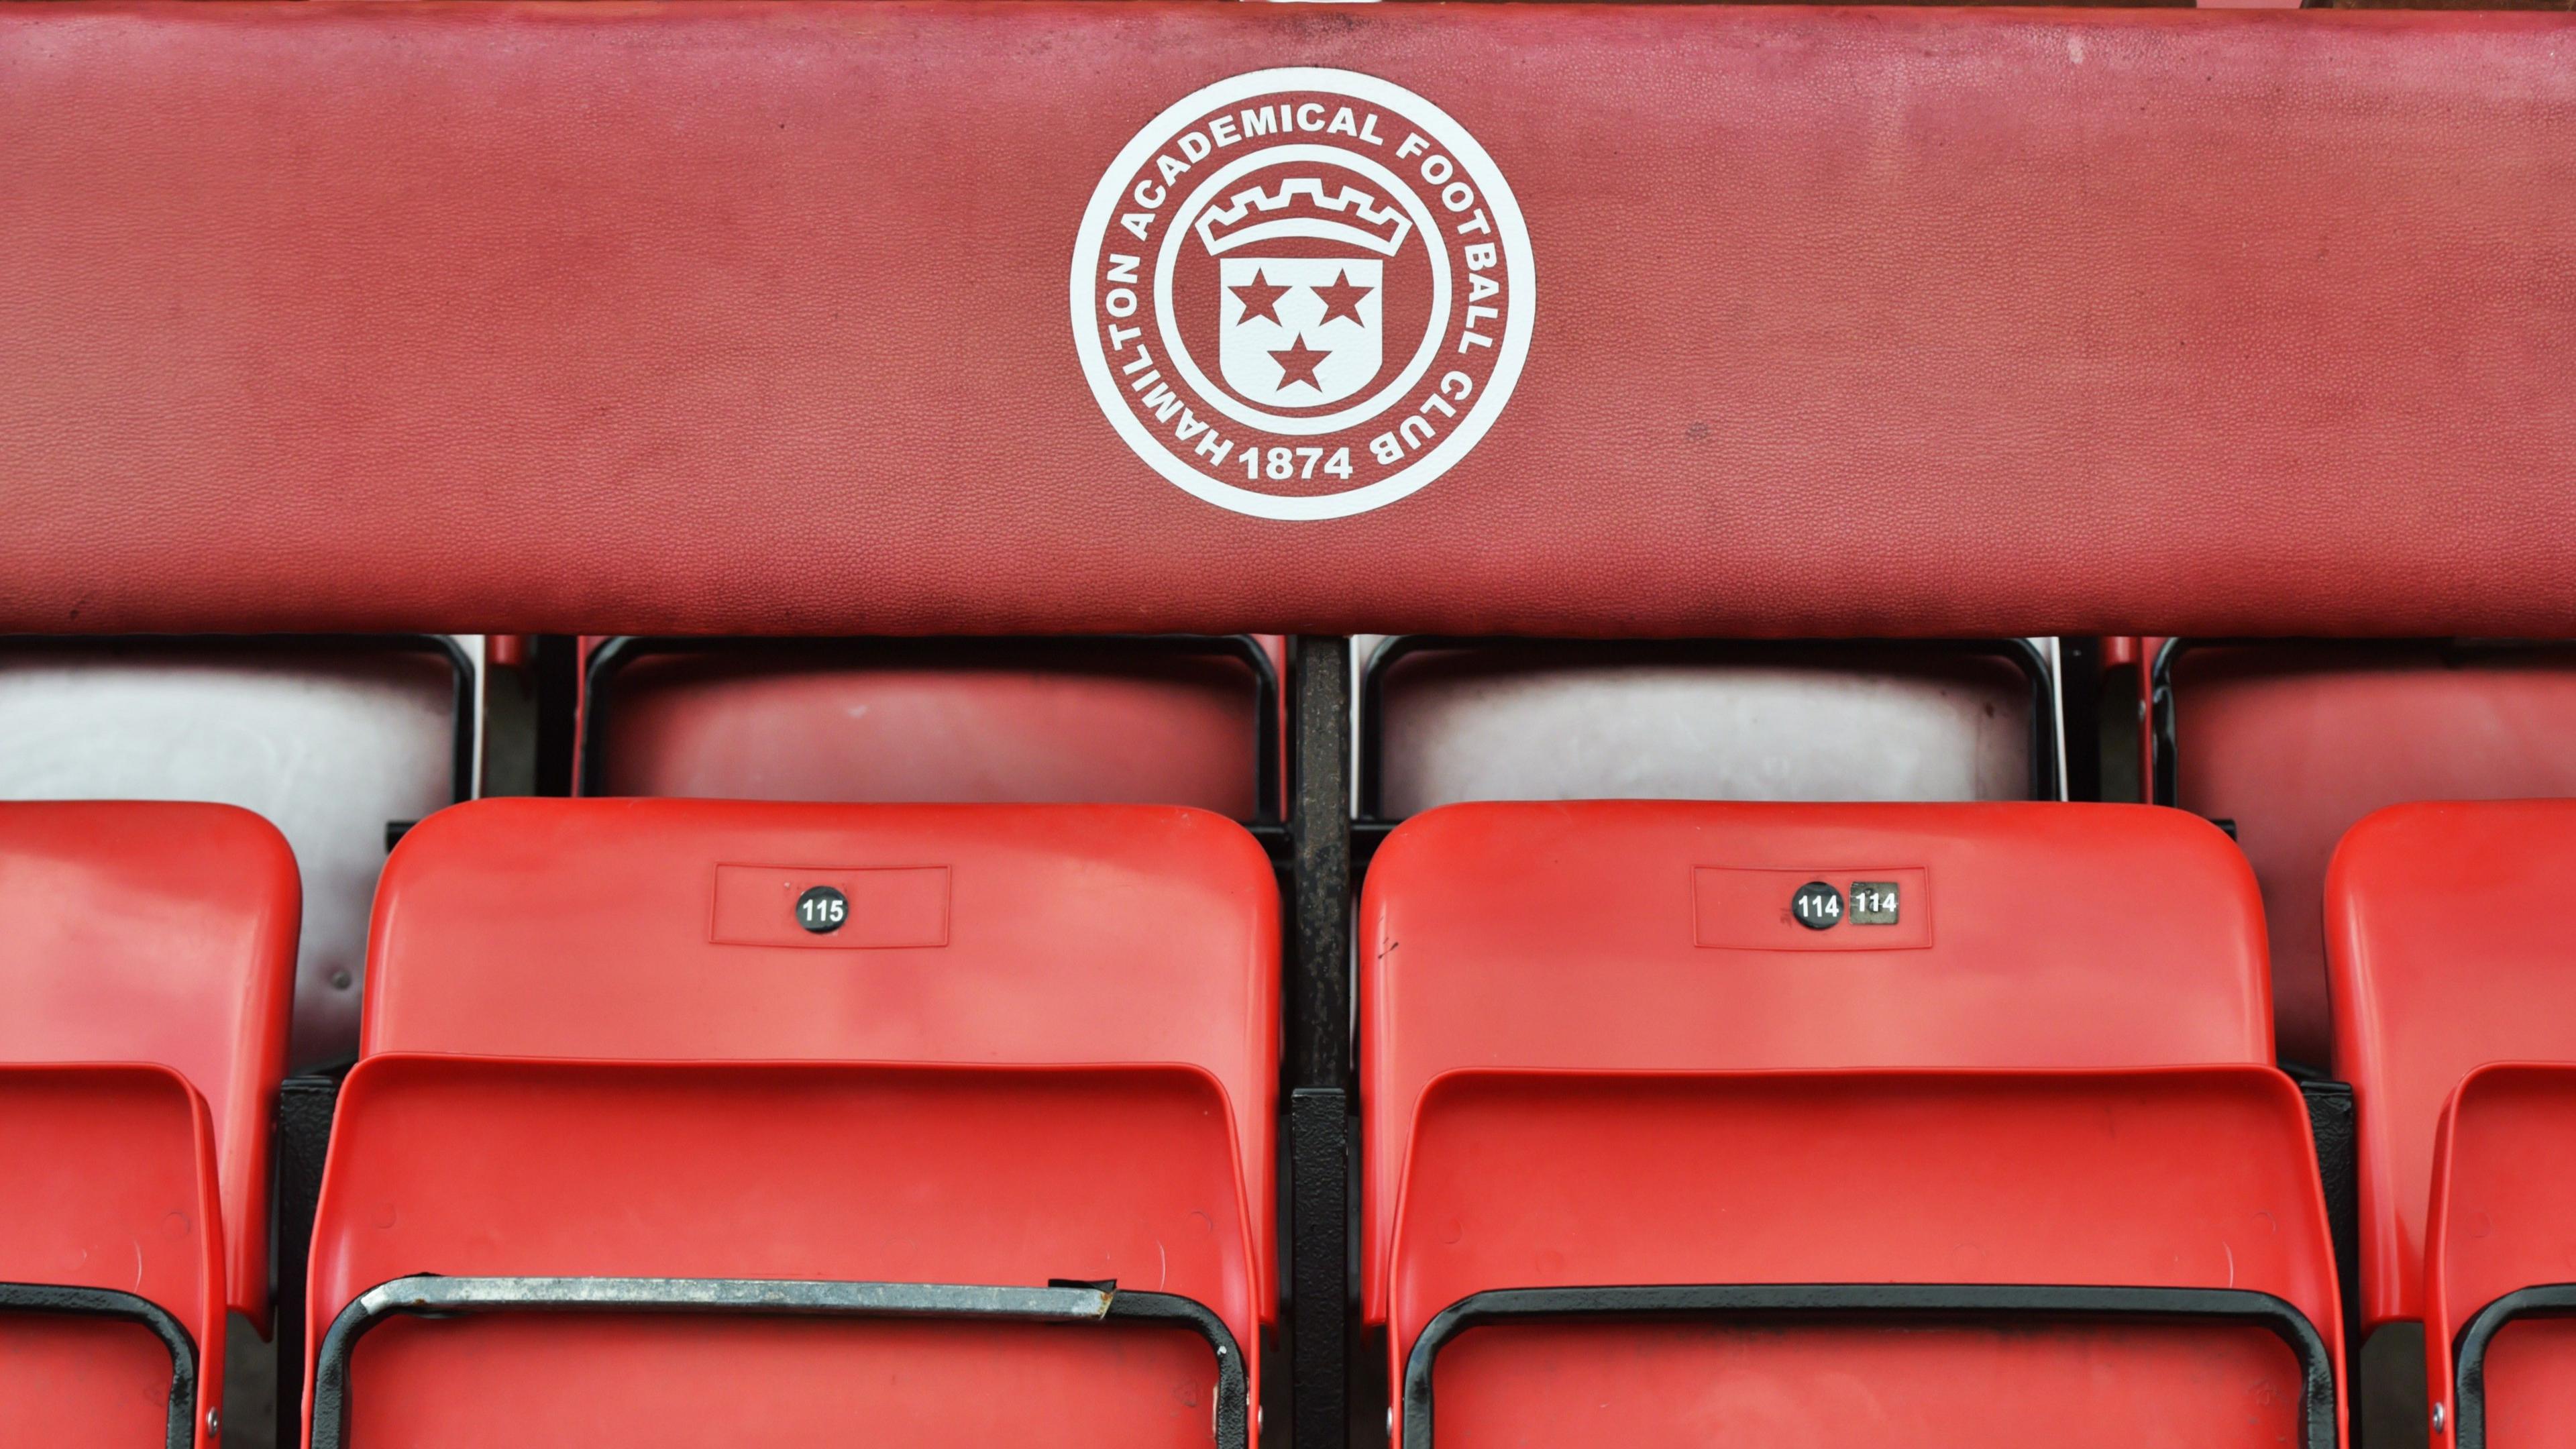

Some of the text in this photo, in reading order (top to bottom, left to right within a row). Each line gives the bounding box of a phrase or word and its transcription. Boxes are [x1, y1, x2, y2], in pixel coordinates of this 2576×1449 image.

[1106, 103, 1499, 466] HAMILTON ACADEMICAL FOOTBALL CLUB
[1238, 447, 1353, 479] 1874
[802, 899, 843, 922] 115
[1799, 895, 1839, 917] 114
[1856, 893, 1896, 912] 114
